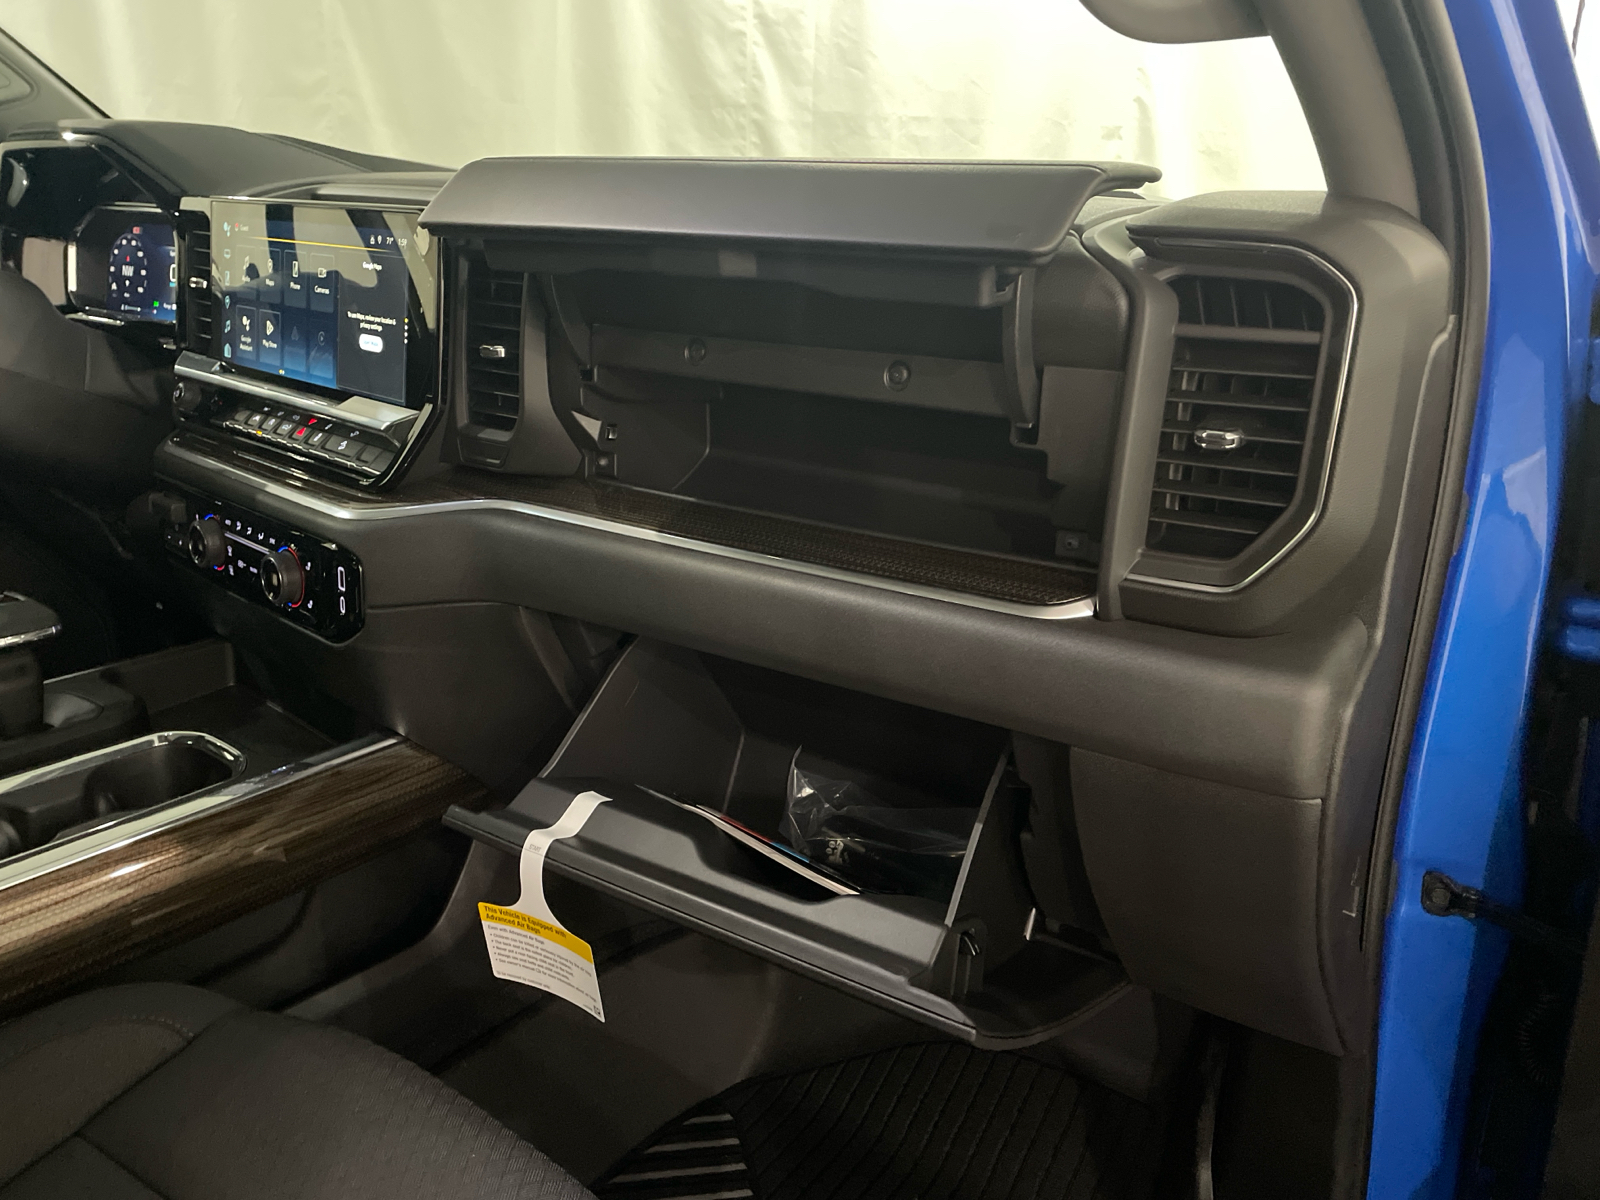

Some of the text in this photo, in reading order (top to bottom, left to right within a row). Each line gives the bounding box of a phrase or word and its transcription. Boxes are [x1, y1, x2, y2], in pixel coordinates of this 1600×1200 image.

[122, 264, 134, 277] NW
[290, 282, 301, 290] Phone
[314, 285, 330, 294] Cameras
[528, 843, 542, 852] START
[484, 906, 497, 914] This
[498, 908, 520, 919] Vehicle
[527, 917, 554, 932] Equipped
[554, 928, 567, 938] with
[486, 913, 516, 925] Advanced
[526, 924, 541, 934] Bags
